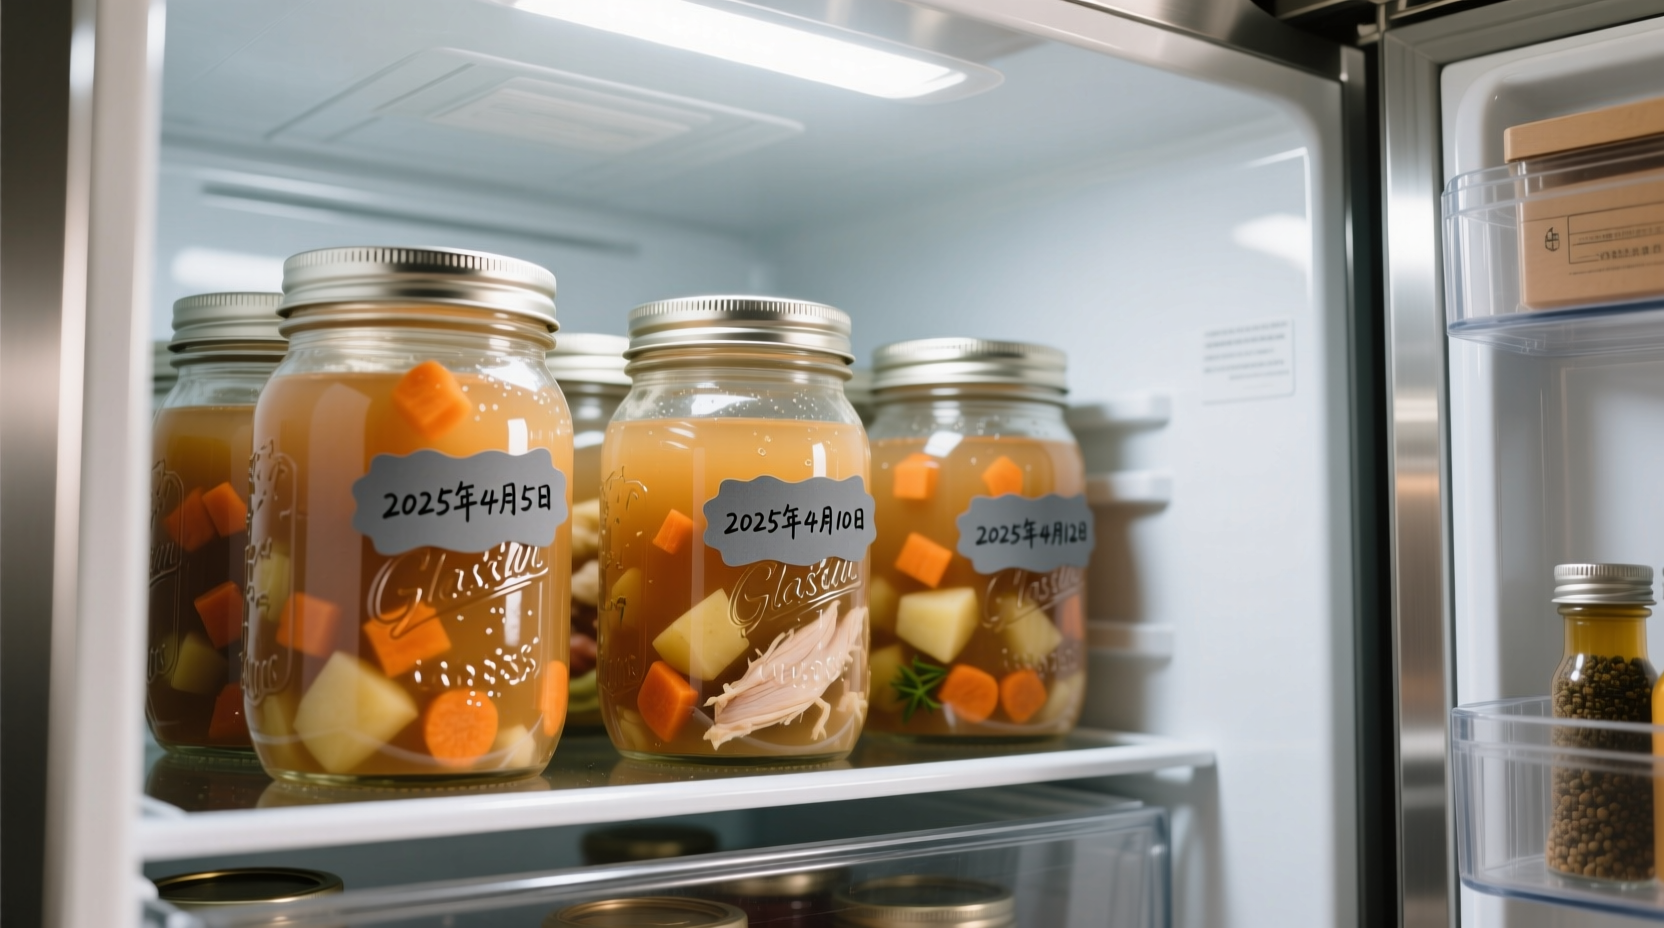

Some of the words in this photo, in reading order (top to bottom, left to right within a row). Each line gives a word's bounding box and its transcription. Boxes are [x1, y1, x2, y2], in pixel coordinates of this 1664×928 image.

[381, 480, 551, 523] 2025年4月5日
[723, 503, 865, 540] 2025年4月10日
[975, 517, 1088, 550] 2025年4月12日
